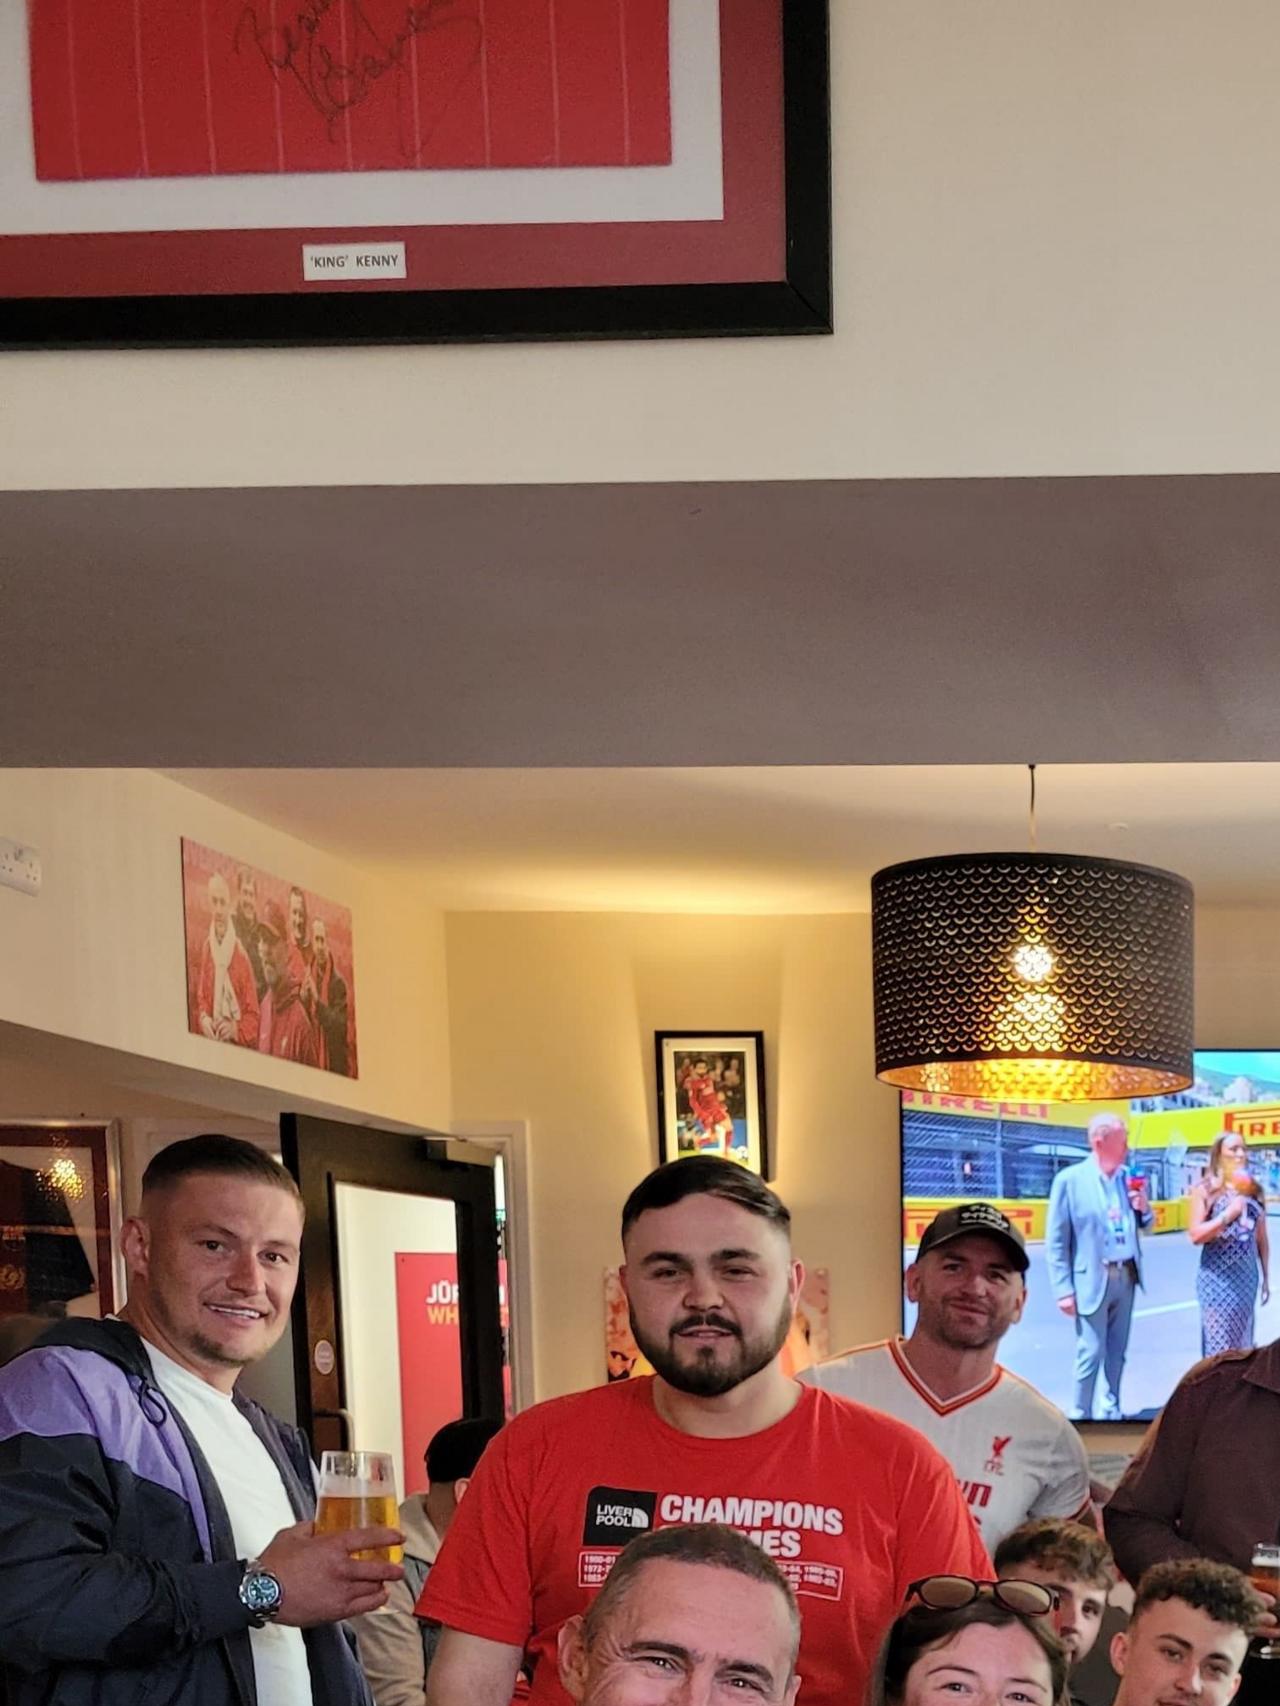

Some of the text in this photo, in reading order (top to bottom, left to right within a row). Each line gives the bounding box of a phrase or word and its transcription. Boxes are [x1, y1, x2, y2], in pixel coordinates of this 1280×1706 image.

[356, 254, 399, 267] KENNY
[596, 1504, 632, 1515] LIVER
[660, 1494, 843, 1535] CHAMPIONS
[596, 1515, 632, 1527] POOL
